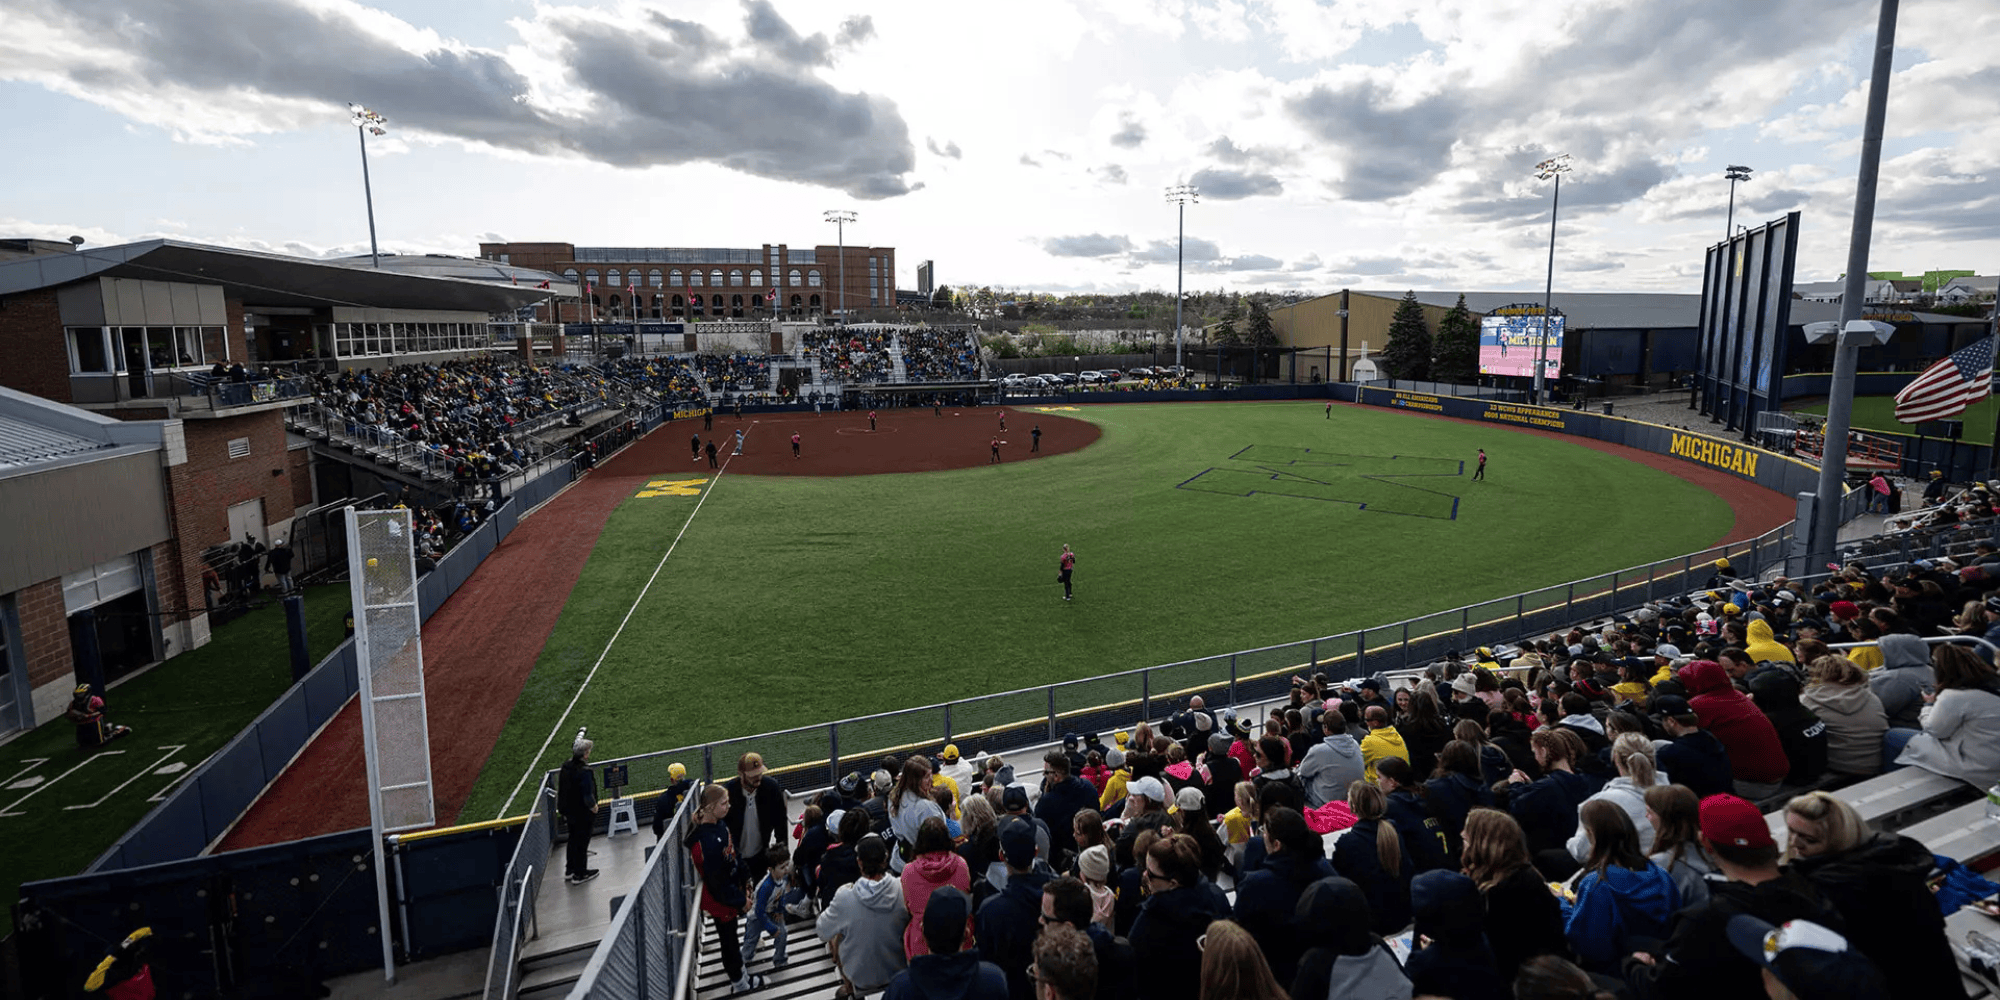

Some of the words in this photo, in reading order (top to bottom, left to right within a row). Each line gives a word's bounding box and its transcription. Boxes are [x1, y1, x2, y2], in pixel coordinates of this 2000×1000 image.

[1508, 336, 1557, 346] MICIGN
[1498, 405, 1516, 413] WCWS
[1517, 407, 1560, 419] APPEARANCES
[1499, 413, 1528, 423] NATIONAL
[1529, 417, 1565, 429] CHAMPIONS
[1670, 432, 1759, 477] MICHIGAN
[1436, 832, 1448, 854] 7
